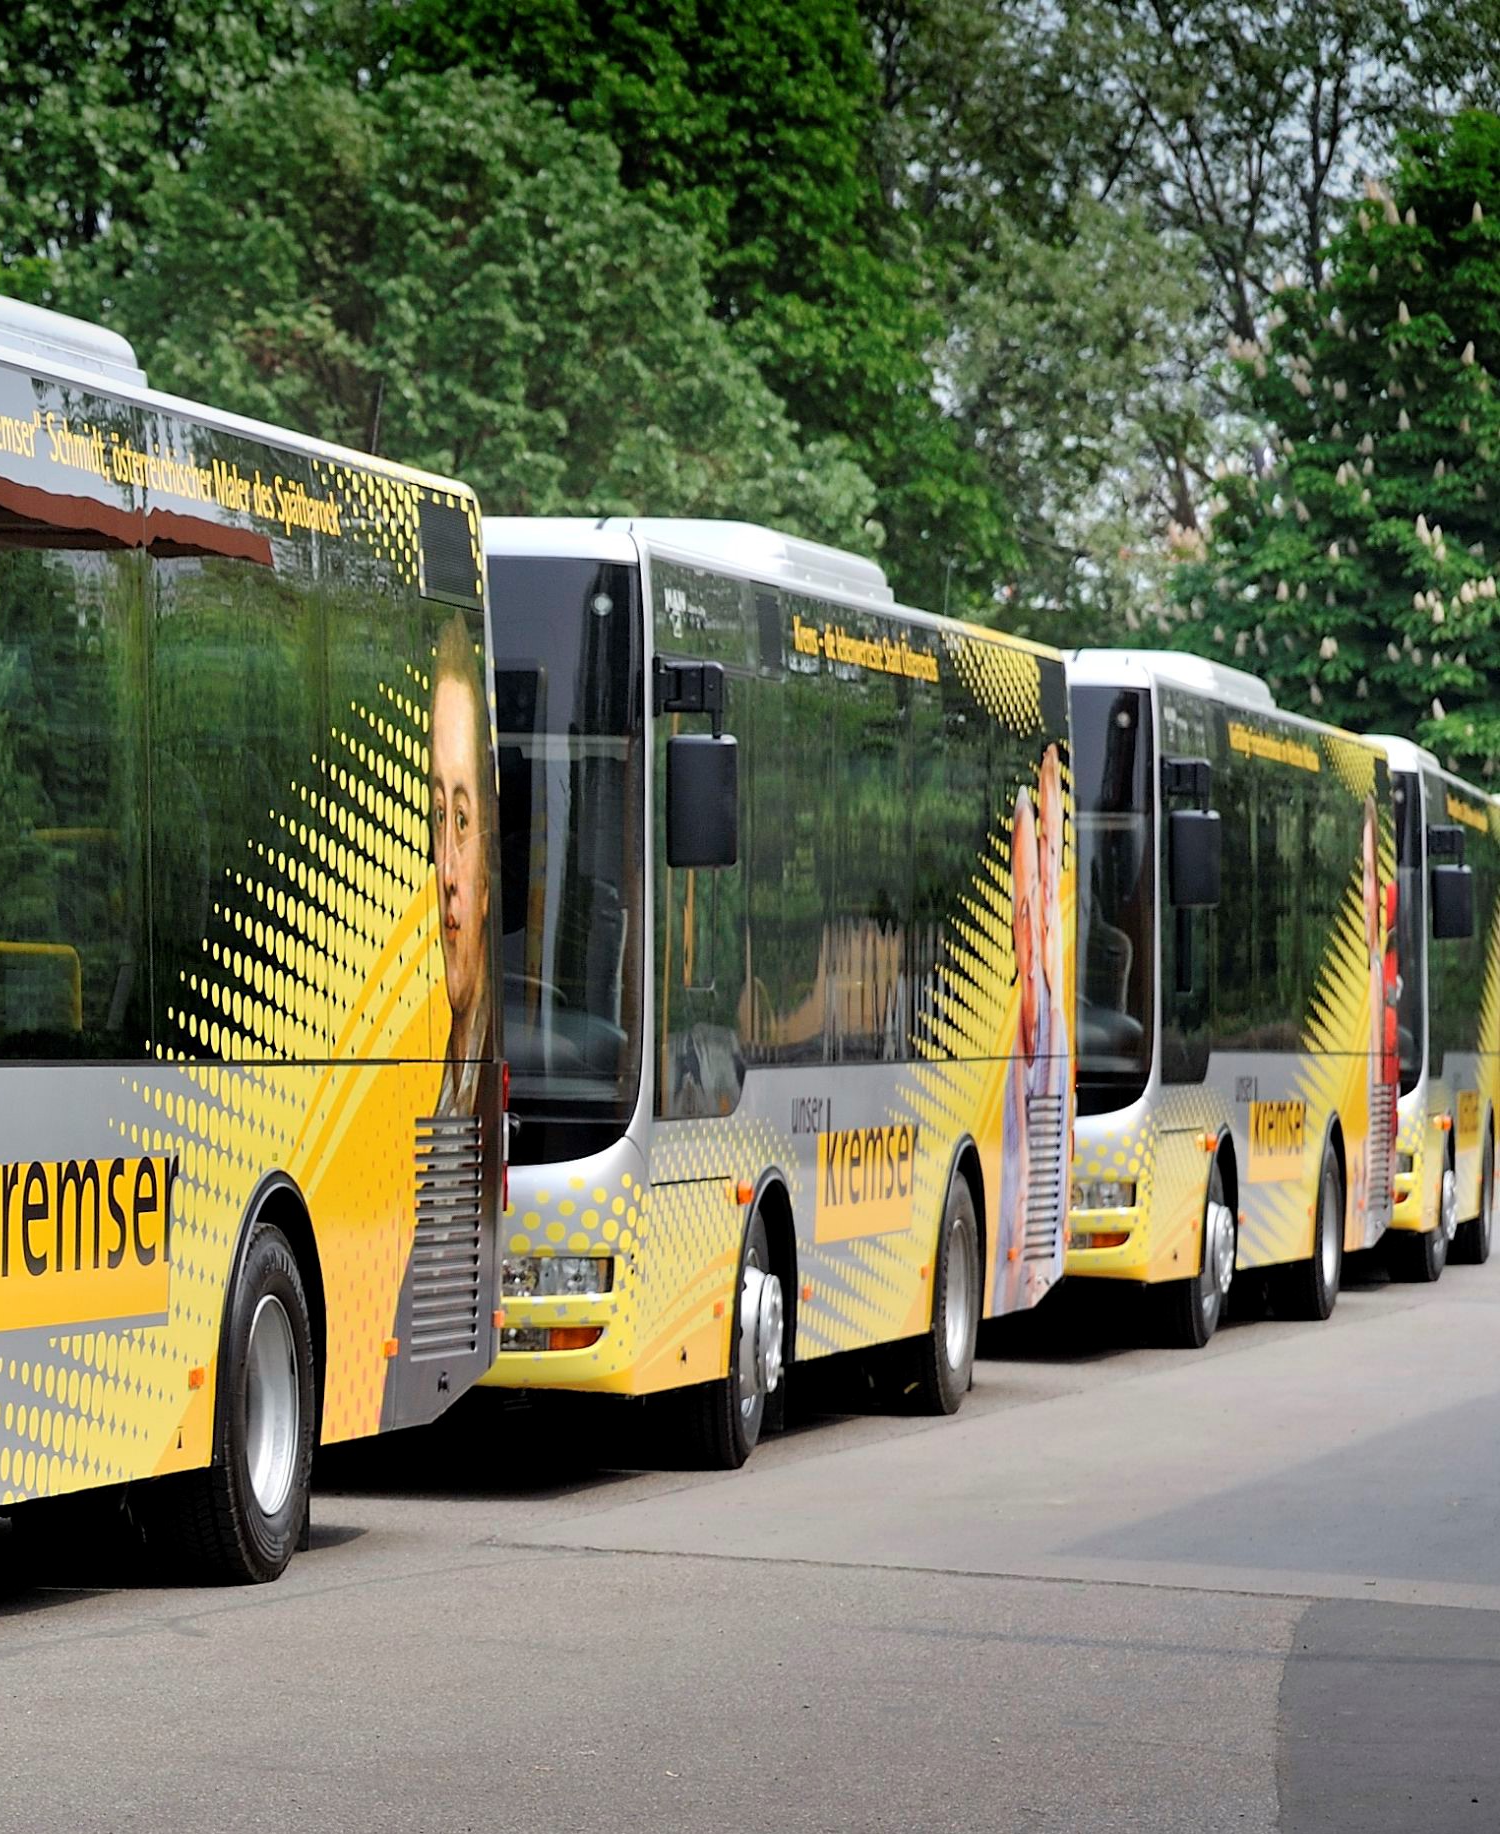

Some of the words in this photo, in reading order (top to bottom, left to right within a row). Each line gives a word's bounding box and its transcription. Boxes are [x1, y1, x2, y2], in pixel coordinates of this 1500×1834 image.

[45, 410, 112, 483] Schmidt,
[110, 432, 212, 503] österreichischer
[212, 458, 251, 513] Maler
[253, 469, 276, 520] des
[274, 475, 342, 537] Spätbarock
[791, 1097, 823, 1134] unser
[823, 1097, 919, 1207] kremser
